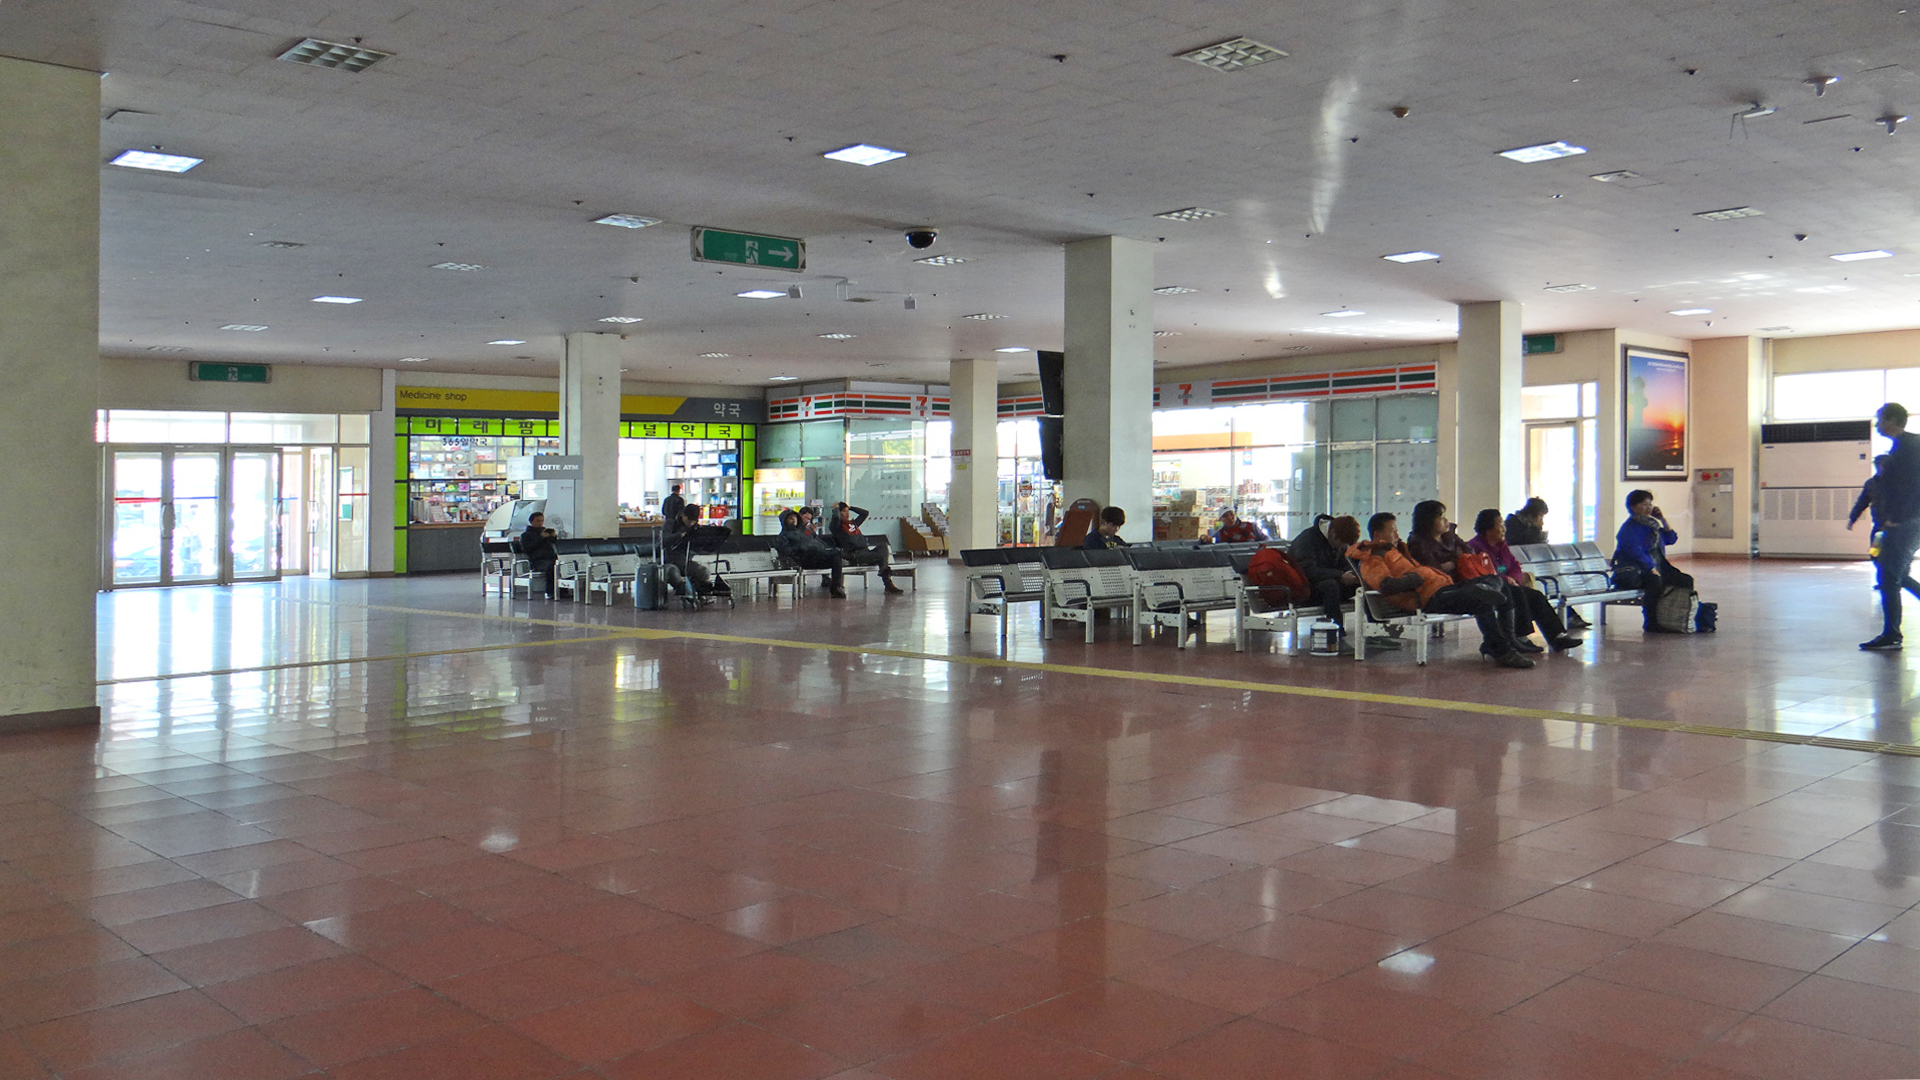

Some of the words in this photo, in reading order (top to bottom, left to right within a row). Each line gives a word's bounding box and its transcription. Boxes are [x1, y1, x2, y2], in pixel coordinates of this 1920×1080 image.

[400, 390, 442, 400] Medicine
[444, 392, 468, 402] shop
[1178, 383, 1192, 405] 7
[713, 402, 741, 418] 약국
[916, 395, 928, 416] 7
[425, 418, 535, 435] 미래팜
